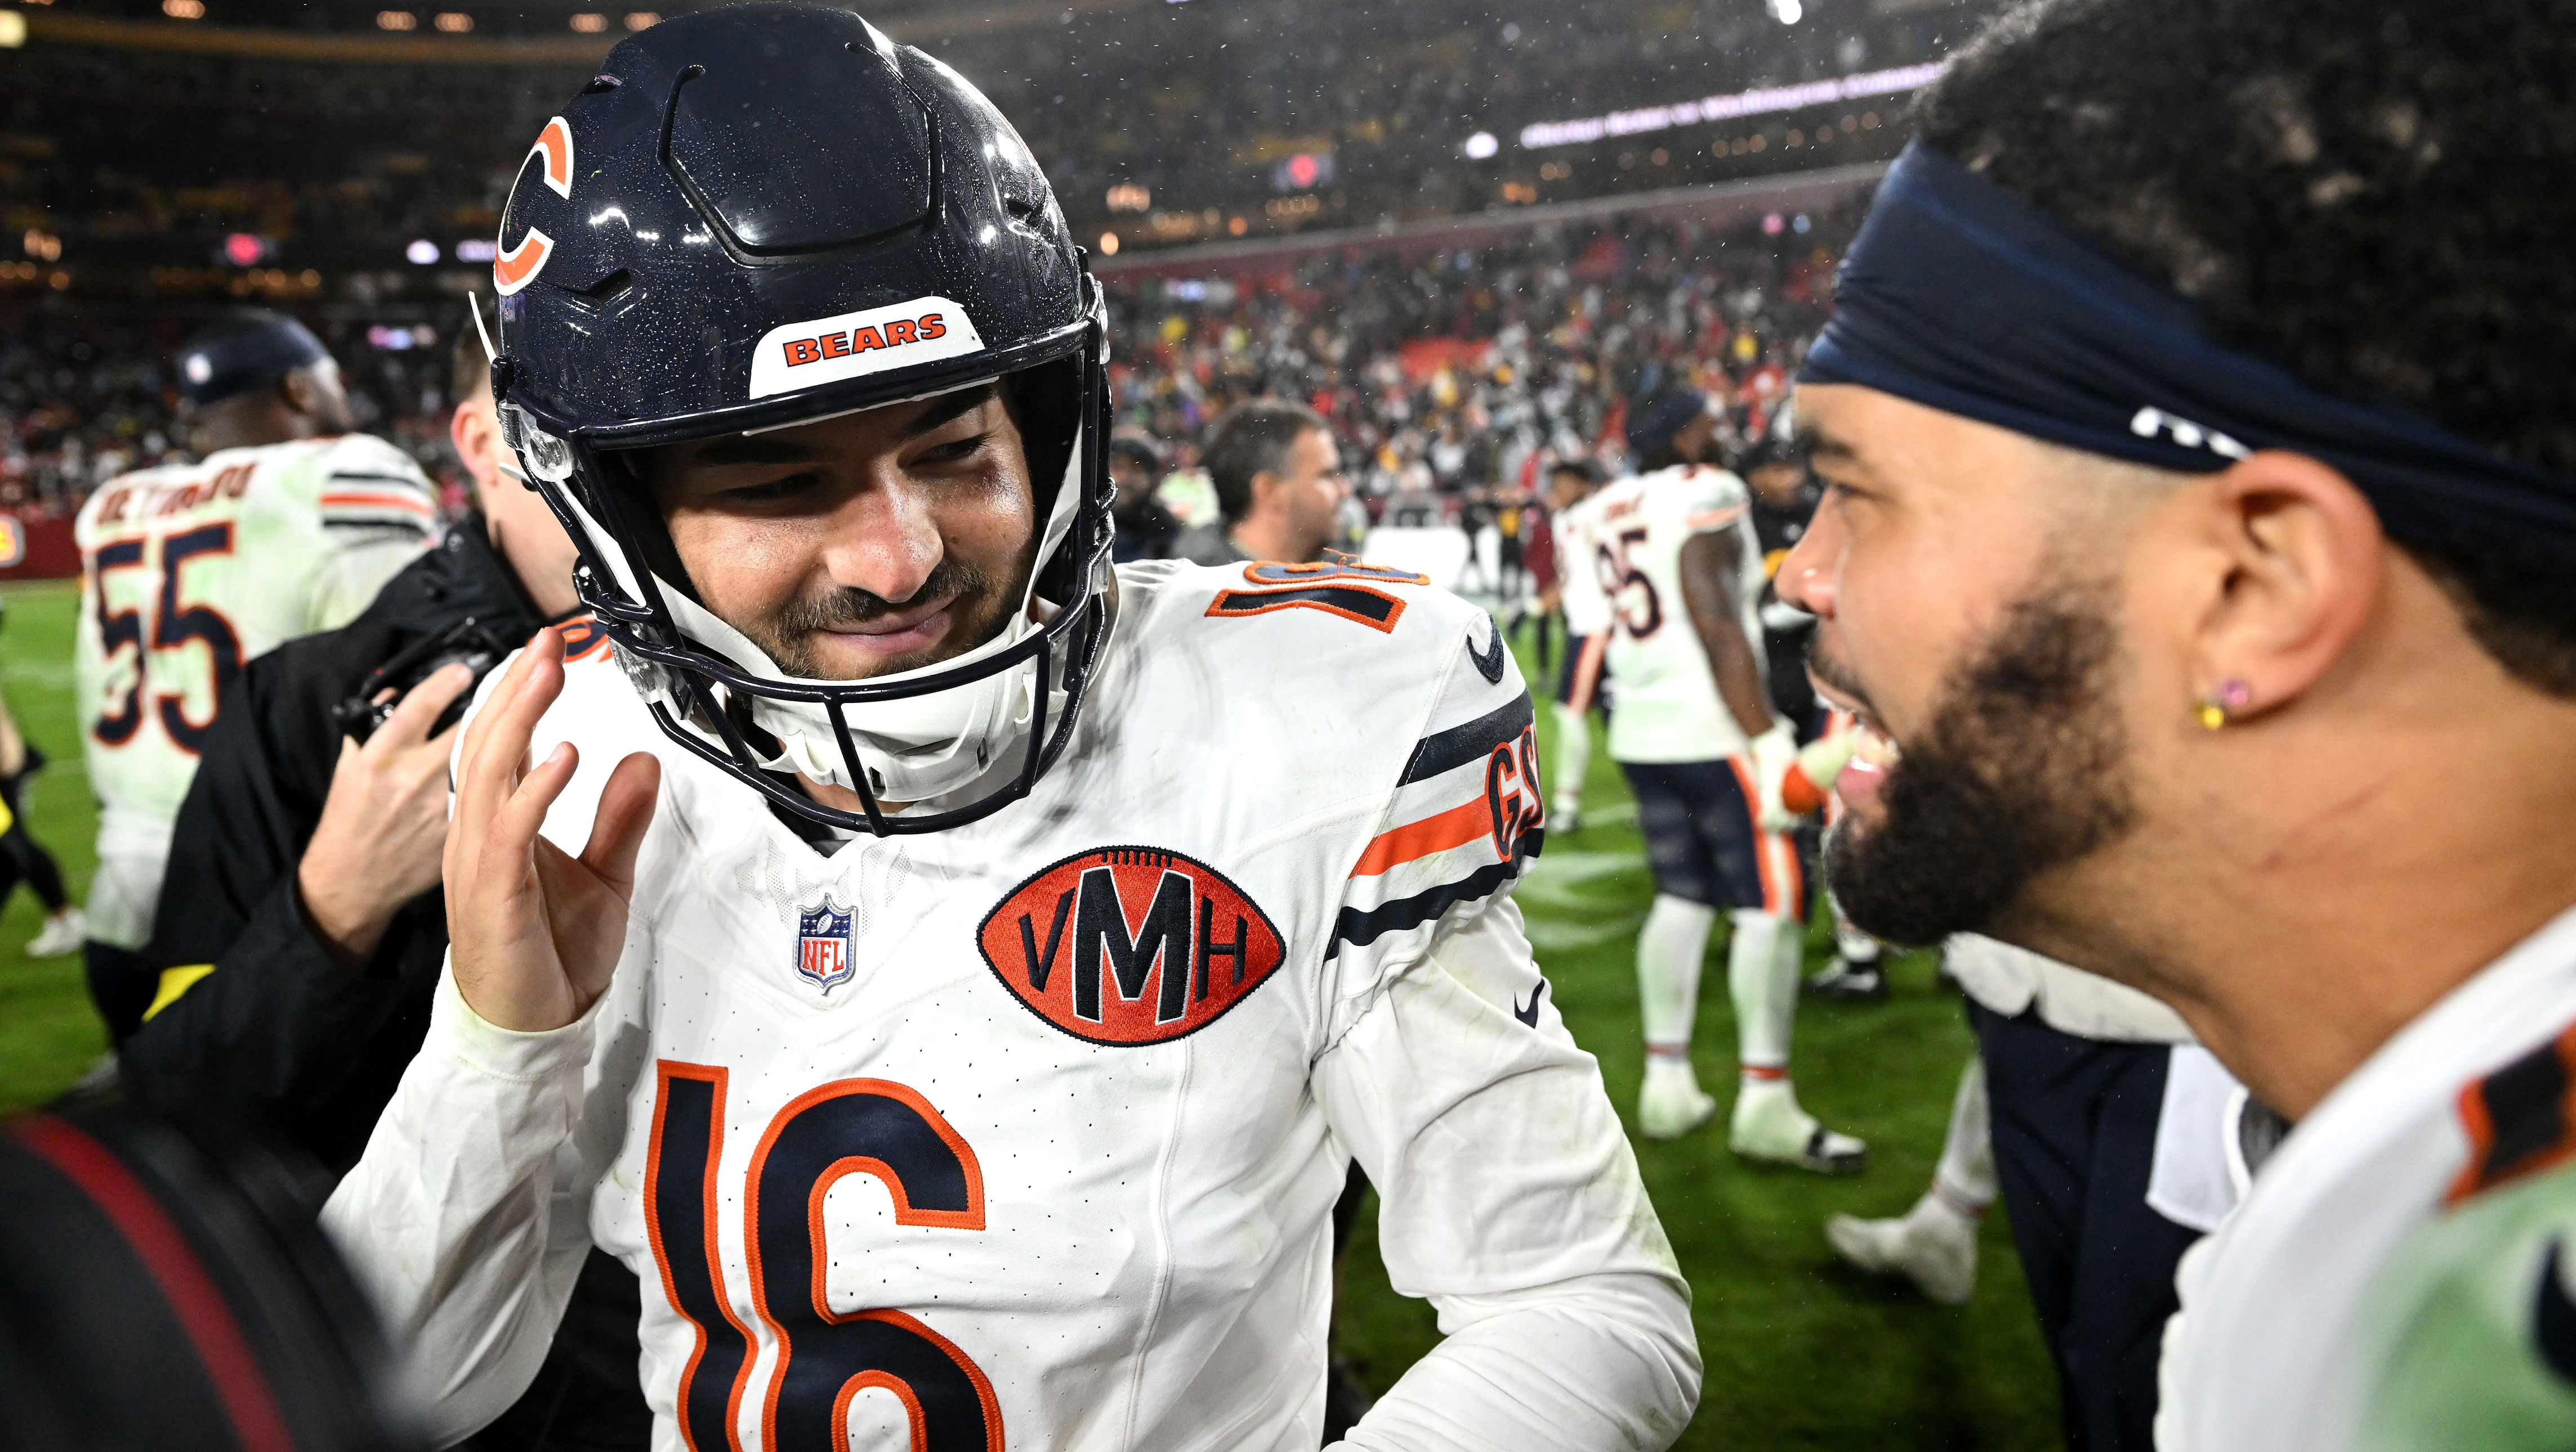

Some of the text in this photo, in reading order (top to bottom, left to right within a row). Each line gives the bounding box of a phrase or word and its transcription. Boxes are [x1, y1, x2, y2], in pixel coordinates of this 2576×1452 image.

[493, 116, 574, 296] C
[782, 313, 948, 368] BEARS
[92, 518, 248, 756] 55
[1484, 724, 1546, 862] GS
[802, 939, 845, 976] NFL
[1018, 865, 1248, 1027] VMH
[643, 1058, 1006, 1452] 16
